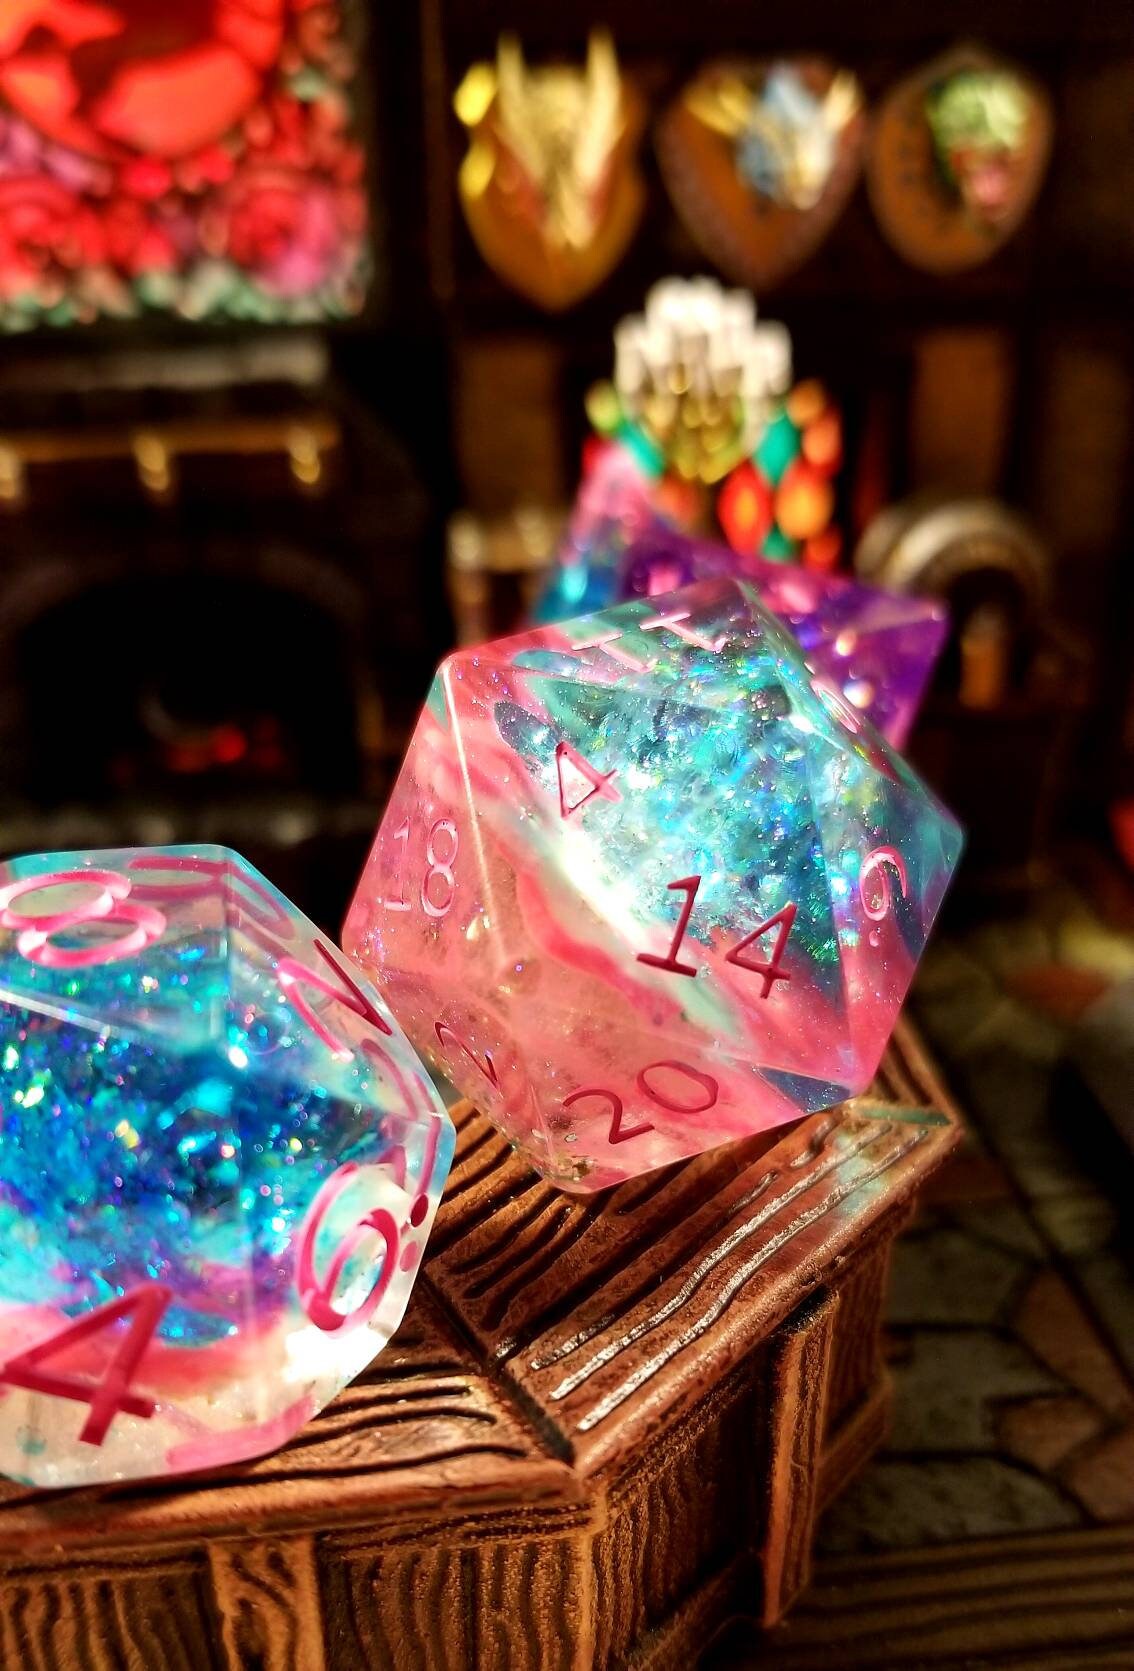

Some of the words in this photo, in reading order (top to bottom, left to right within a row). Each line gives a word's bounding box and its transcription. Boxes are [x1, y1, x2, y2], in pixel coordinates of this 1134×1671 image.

[555, 741, 624, 819] 4
[383, 817, 459, 917] 18
[0, 868, 167, 969] 8
[636, 874, 799, 1000] 14
[562, 1060, 720, 1145] 20
[0, 1281, 175, 1448] 4
